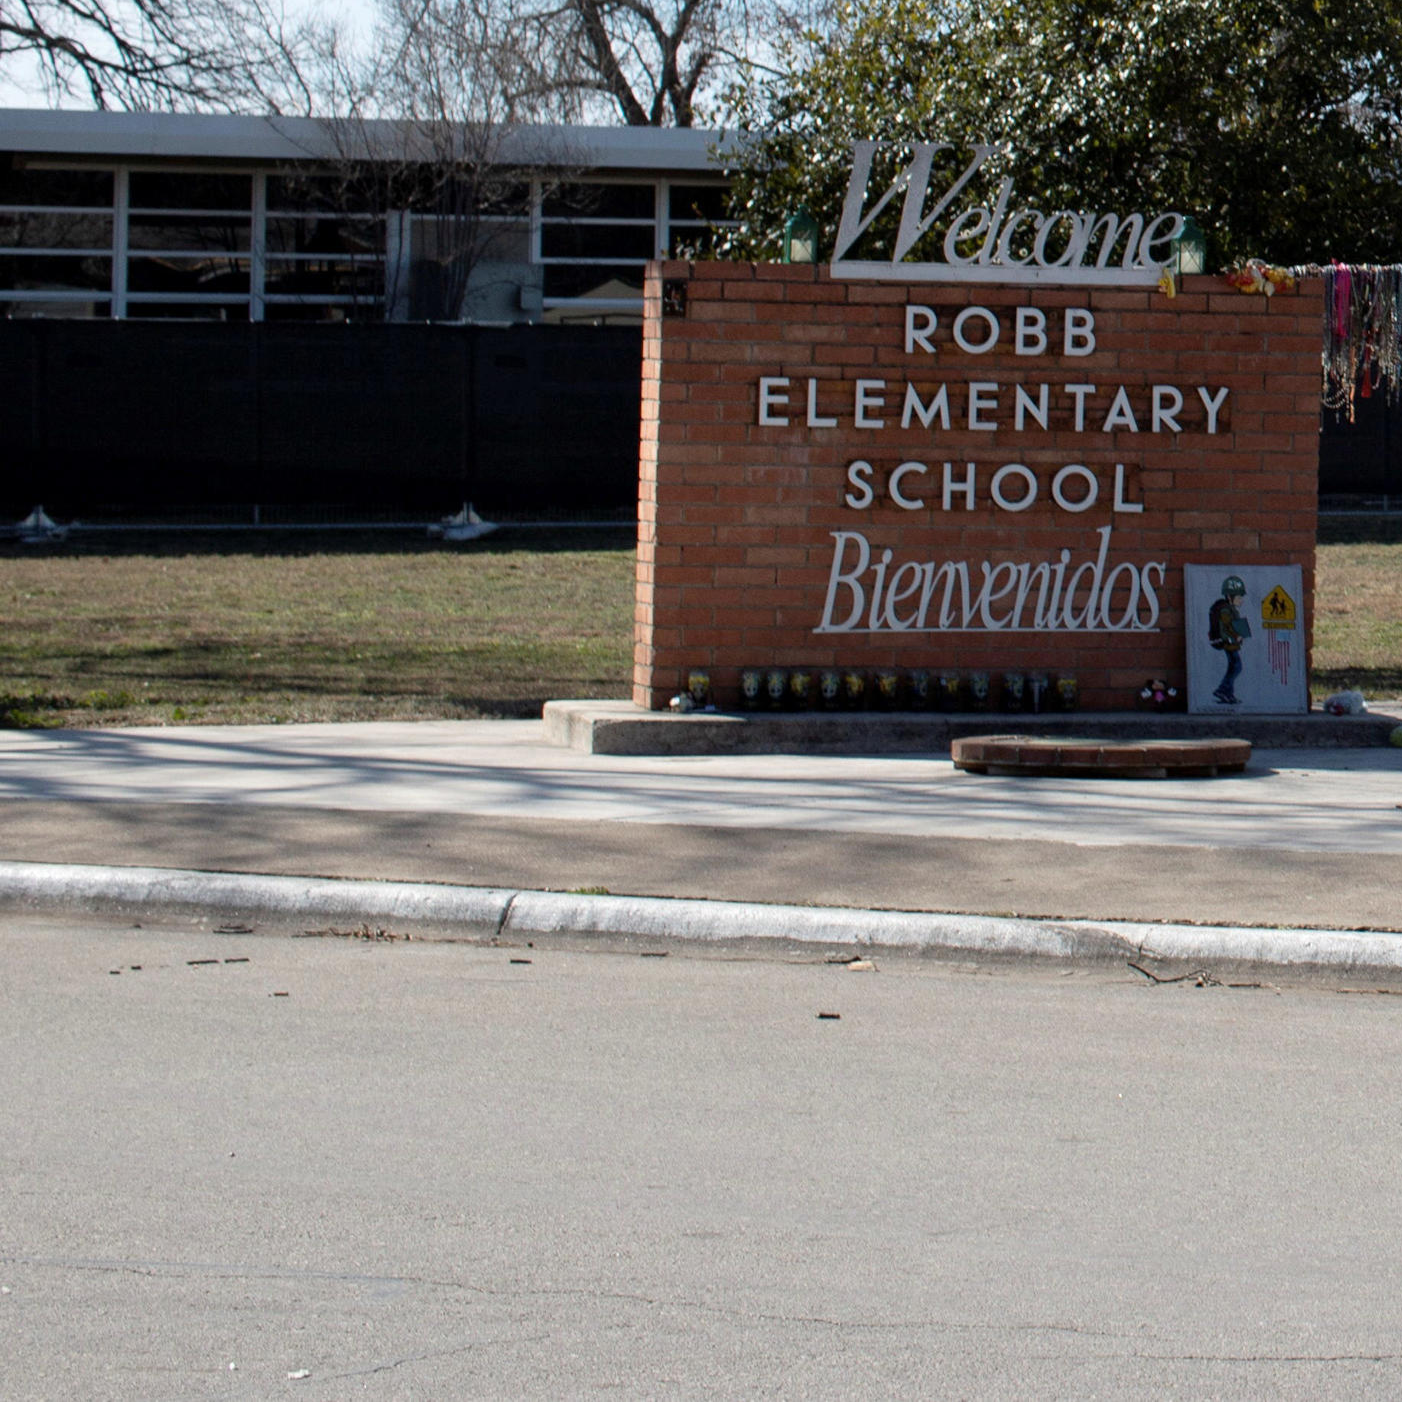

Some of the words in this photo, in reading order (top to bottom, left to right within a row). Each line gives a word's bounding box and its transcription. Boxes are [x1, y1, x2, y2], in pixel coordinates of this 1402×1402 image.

[832, 140, 1184, 268] Welcome
[904, 304, 1096, 357] ROBB
[758, 376, 1229, 434] ELEMENTARY
[845, 460, 1144, 513] SCHOOL
[820, 525, 1166, 630] Bienvenidos
